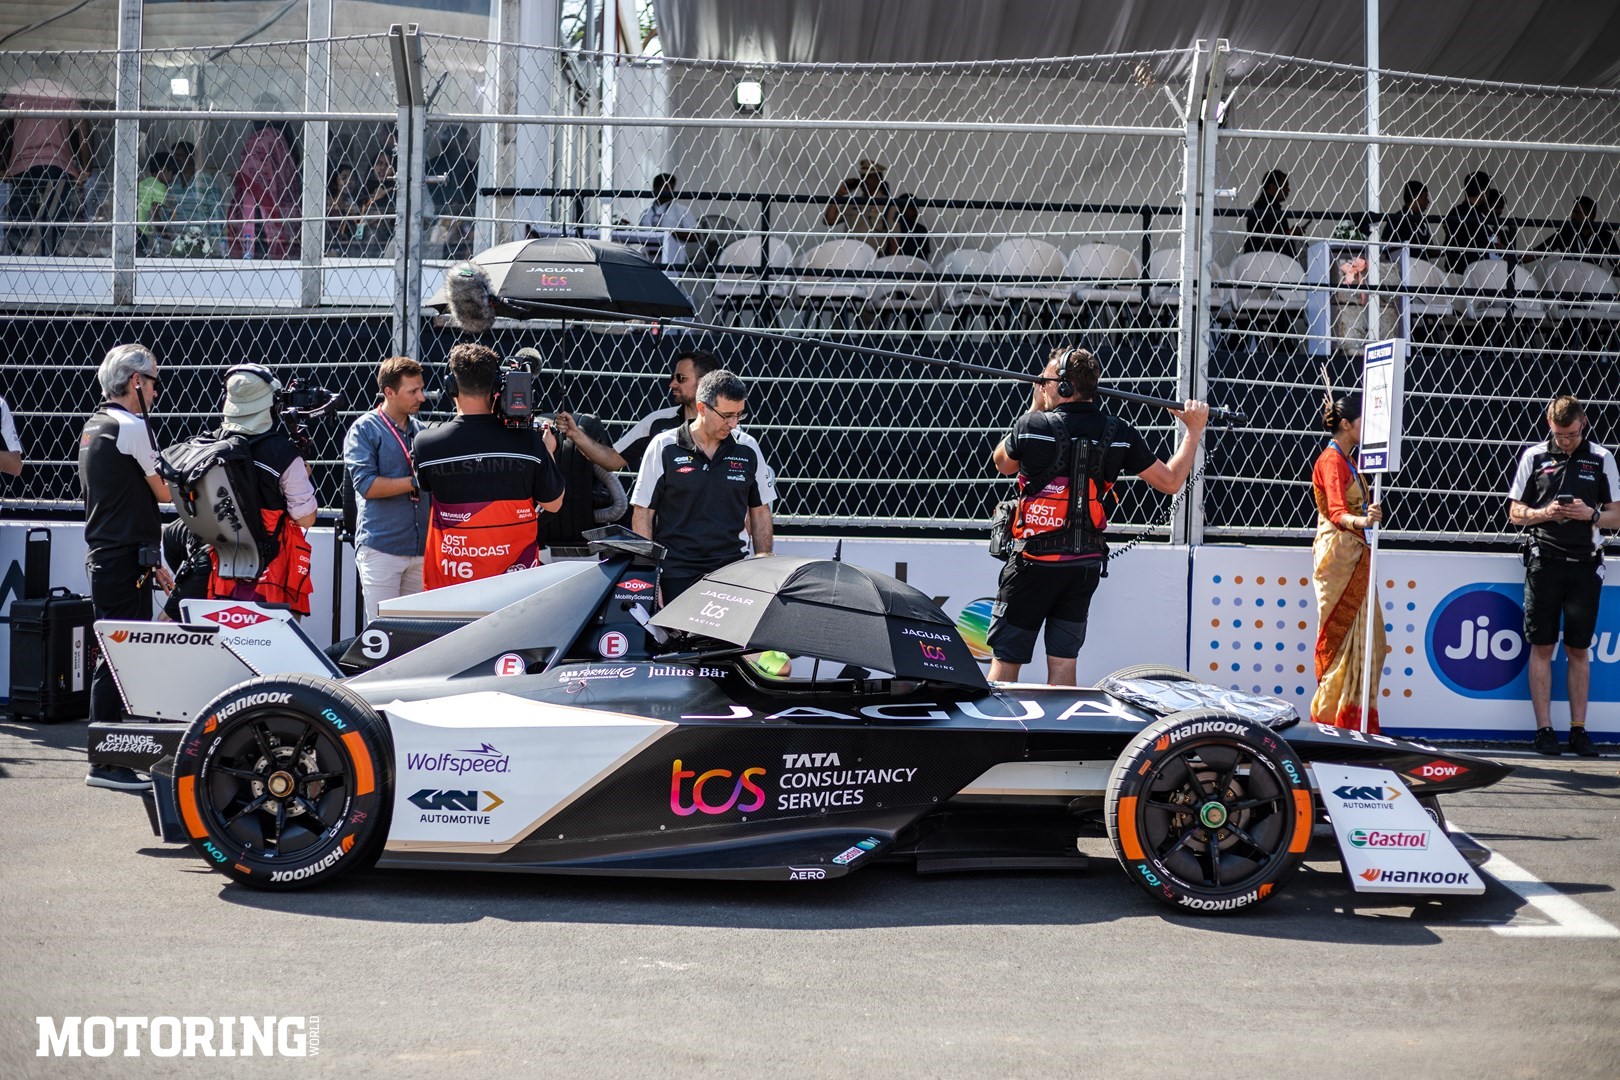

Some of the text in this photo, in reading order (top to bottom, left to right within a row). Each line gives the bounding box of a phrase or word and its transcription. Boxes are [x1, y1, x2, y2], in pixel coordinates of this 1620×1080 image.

[541, 273, 567, 286] tcs
[441, 558, 474, 579] 116
[700, 590, 754, 606] JAGUAR
[700, 600, 729, 619] tcs
[688, 616, 721, 627] RACING
[902, 628, 952, 642] JAGUAR
[1444, 615, 1523, 661] Jio
[361, 629, 390, 660] 9
[606, 636, 620, 654] E
[919, 640, 946, 661] tcs
[502, 658, 517, 674] E
[648, 666, 729, 678] Julius Bär
[923, 662, 954, 671] RACING
[680, 701, 1147, 721] JAGUA
[407, 752, 510, 776] Wolfspeed
[782, 752, 840, 769] TATA
[779, 767, 918, 788] CONSULTANCY
[670, 759, 766, 816] tcs
[777, 789, 864, 811] SERVICES
[1343, 802, 1394, 810] AUTOMOTIVE
[420, 814, 490, 825] AUTOMOTIVE
[1368, 831, 1426, 848] Castrol
[789, 871, 825, 880] AERO
